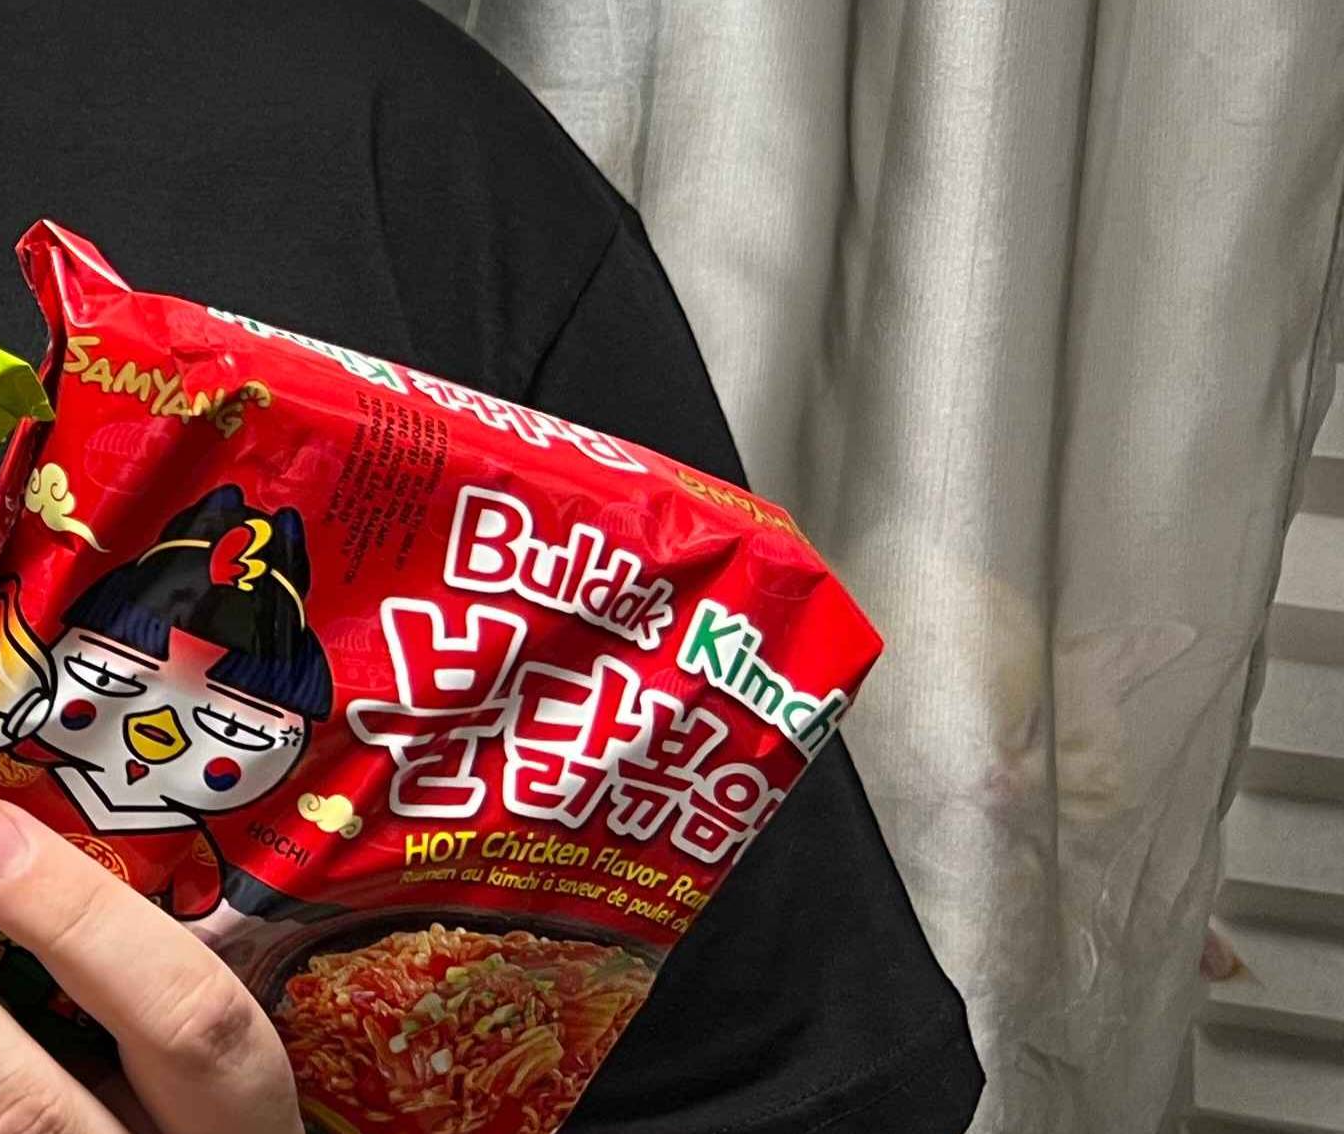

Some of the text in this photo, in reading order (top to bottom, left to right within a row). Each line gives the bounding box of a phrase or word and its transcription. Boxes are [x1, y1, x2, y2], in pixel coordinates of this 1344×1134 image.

[62, 335, 245, 439] SAMYANG
[448, 490, 672, 644] Buldak
[684, 607, 843, 754] Kimch
[247, 820, 311, 868] HOCHI
[405, 831, 477, 865] HOT
[480, 829, 590, 867] Chicken
[591, 847, 669, 889] Flavor
[461, 867, 481, 883] au
[487, 865, 541, 891] kimchi
[555, 879, 607, 900] saveur
[606, 886, 629, 908] de
[624, 897, 676, 926] poulet
